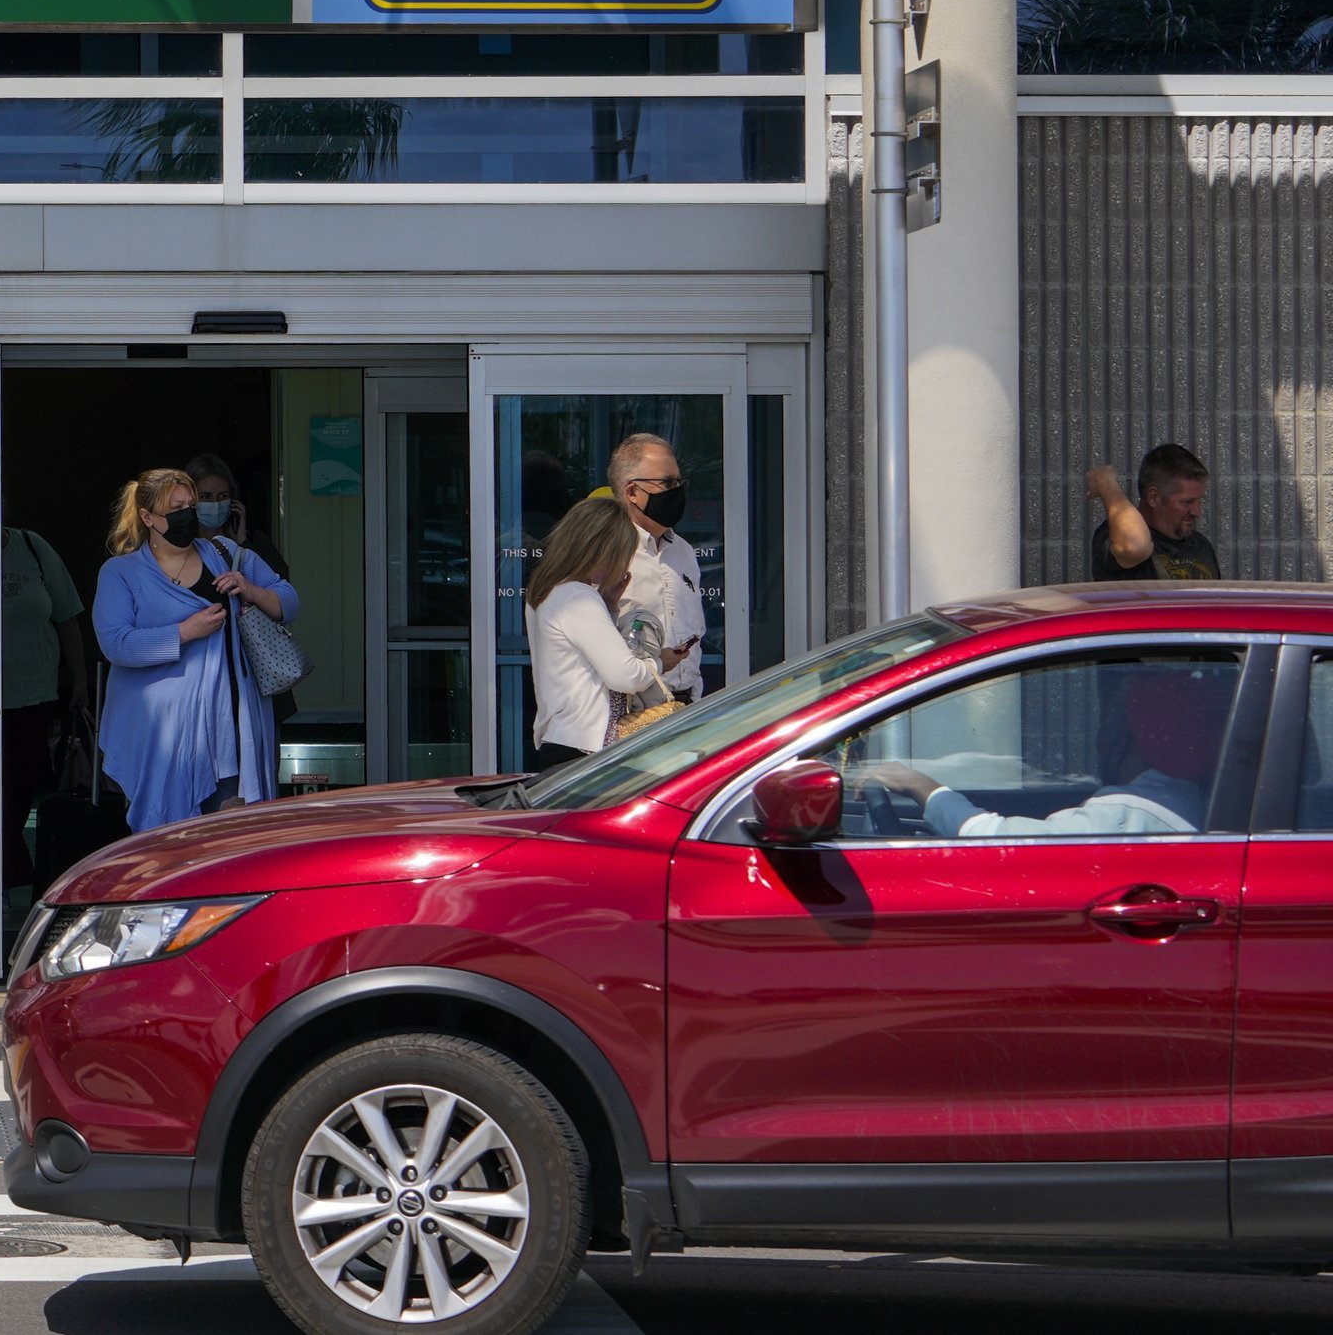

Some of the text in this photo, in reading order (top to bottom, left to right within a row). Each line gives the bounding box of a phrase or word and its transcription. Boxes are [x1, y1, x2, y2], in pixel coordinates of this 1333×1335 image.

[502, 548, 543, 558] THIS IS
[694, 548, 715, 558] ENT
[498, 587, 515, 597] NO
[699, 587, 721, 597] 0.01
